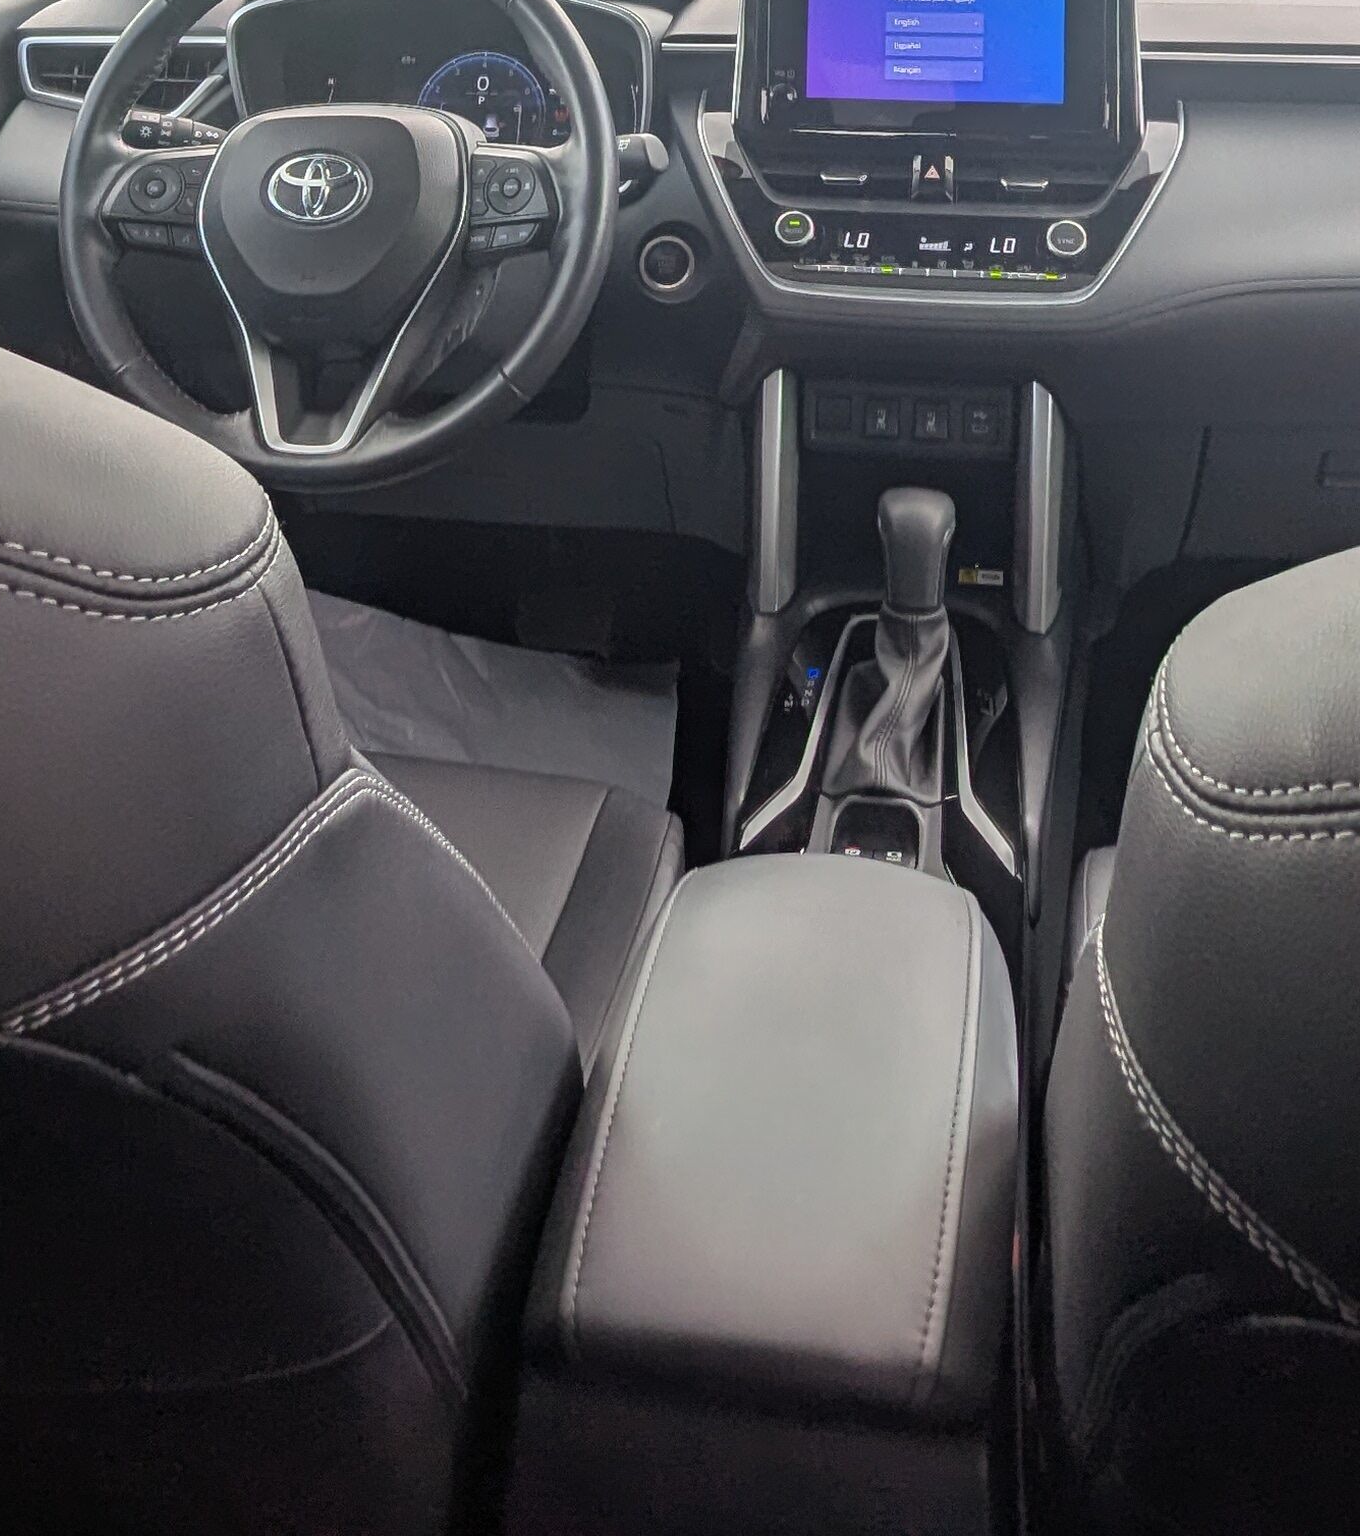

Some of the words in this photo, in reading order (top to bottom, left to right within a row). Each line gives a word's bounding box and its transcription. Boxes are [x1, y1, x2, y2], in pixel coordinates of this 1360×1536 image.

[894, 18, 920, 28] English
[476, 76, 490, 91] 0
[478, 96, 485, 105] P
[844, 231, 870, 248] LO
[990, 237, 1017, 253] LO
